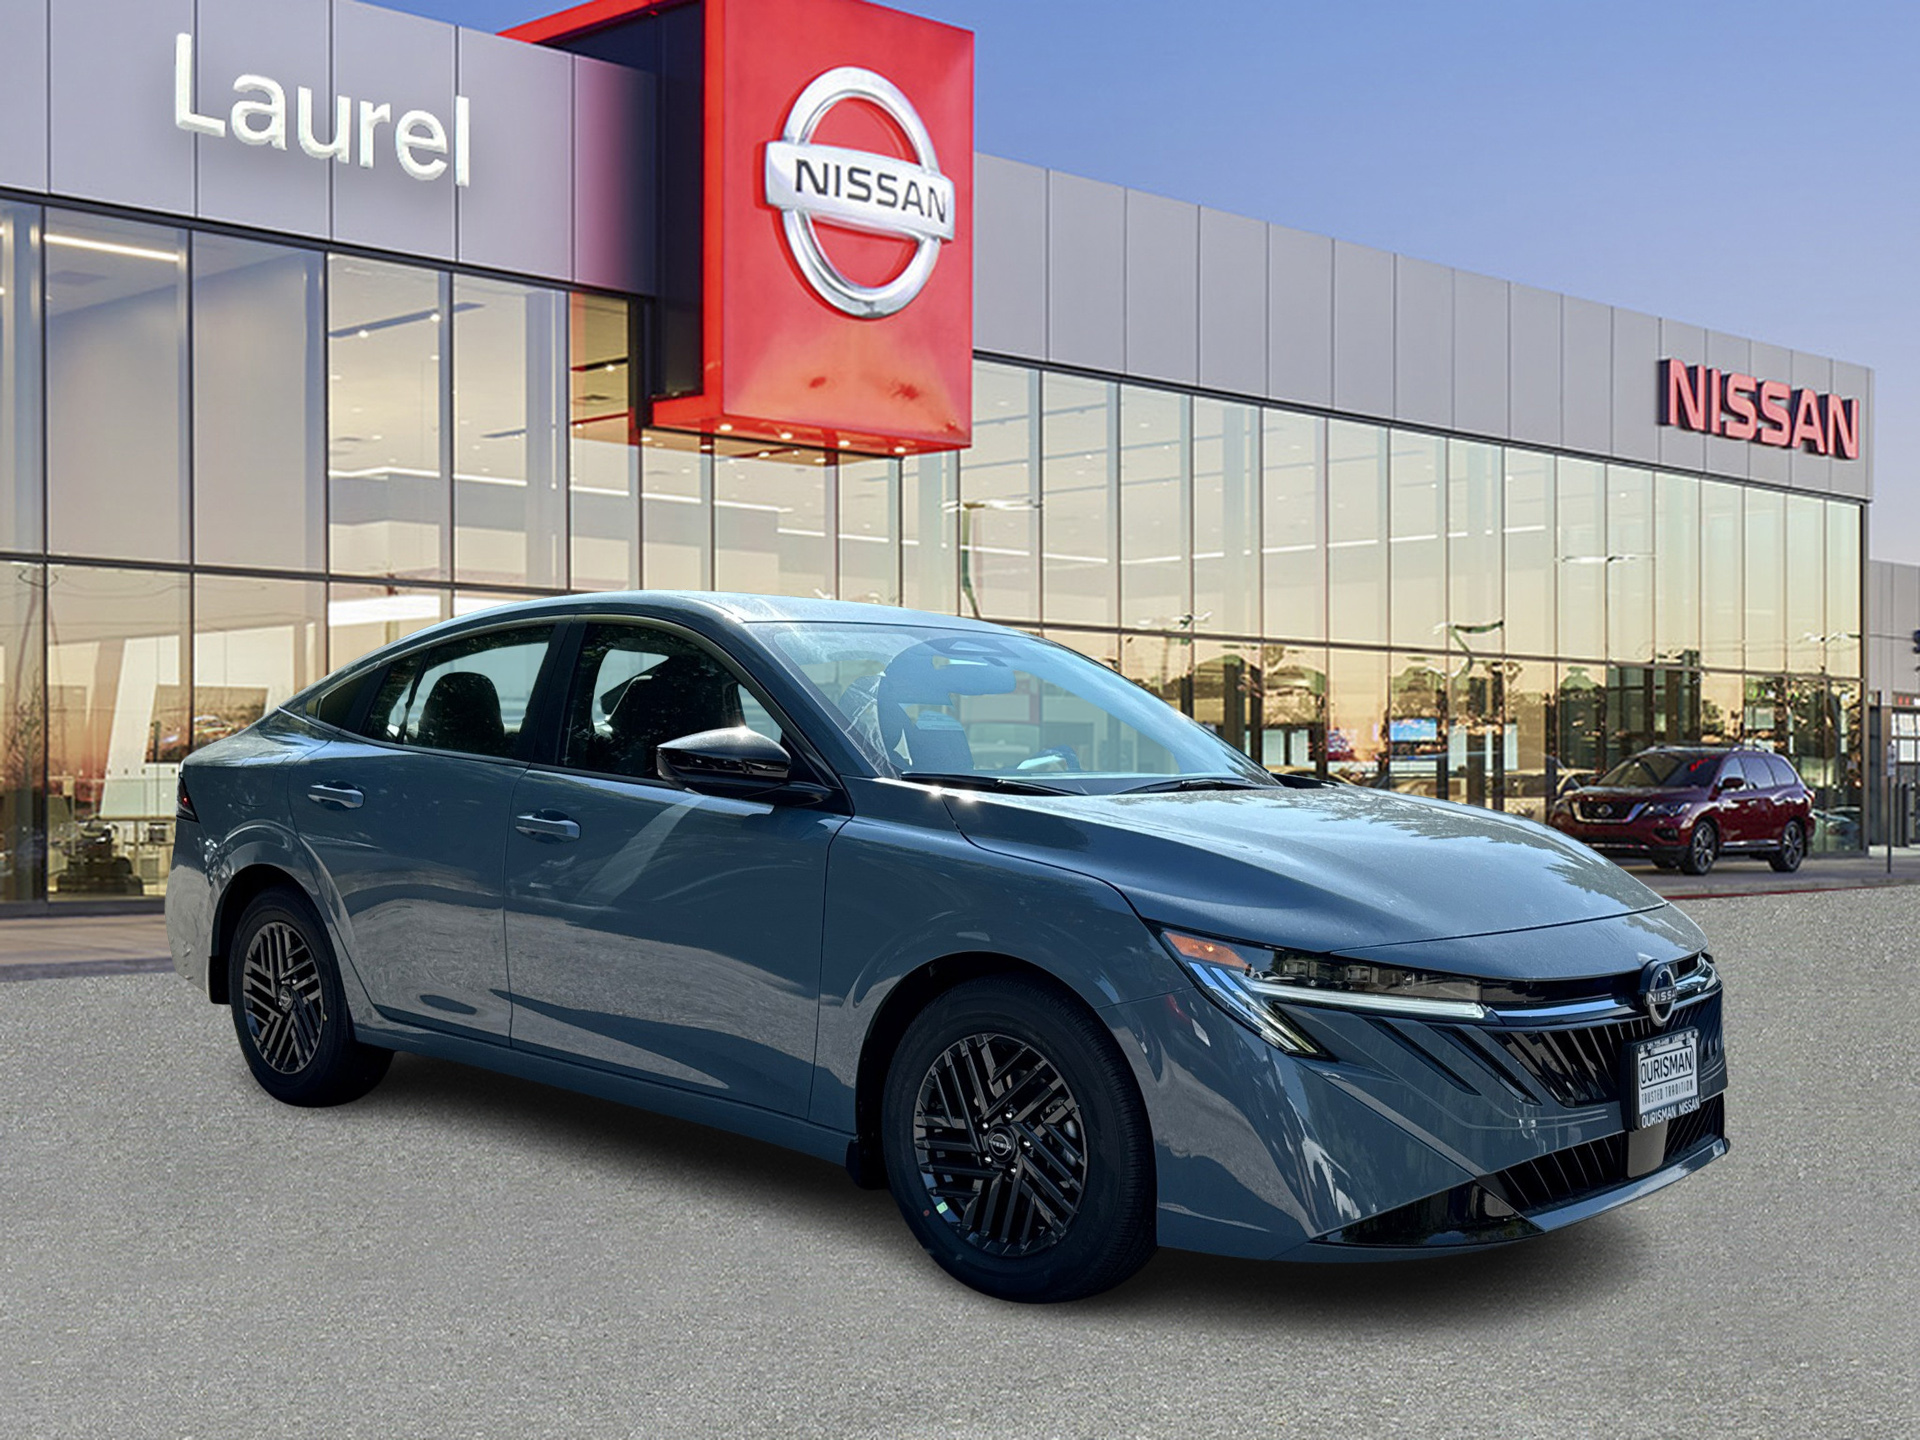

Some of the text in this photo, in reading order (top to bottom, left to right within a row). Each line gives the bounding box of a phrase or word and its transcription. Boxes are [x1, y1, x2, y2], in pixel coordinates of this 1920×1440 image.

[175, 33, 470, 188] Laurel
[795, 158, 947, 224] NISSAN
[1661, 358, 1860, 460] NISSAN
[1640, 1050, 1693, 1084] OURISMAN
[1641, 1079, 1693, 1106] TRUSTED TRADITION
[1641, 1096, 1700, 1129] OURISMAN NISSAN
